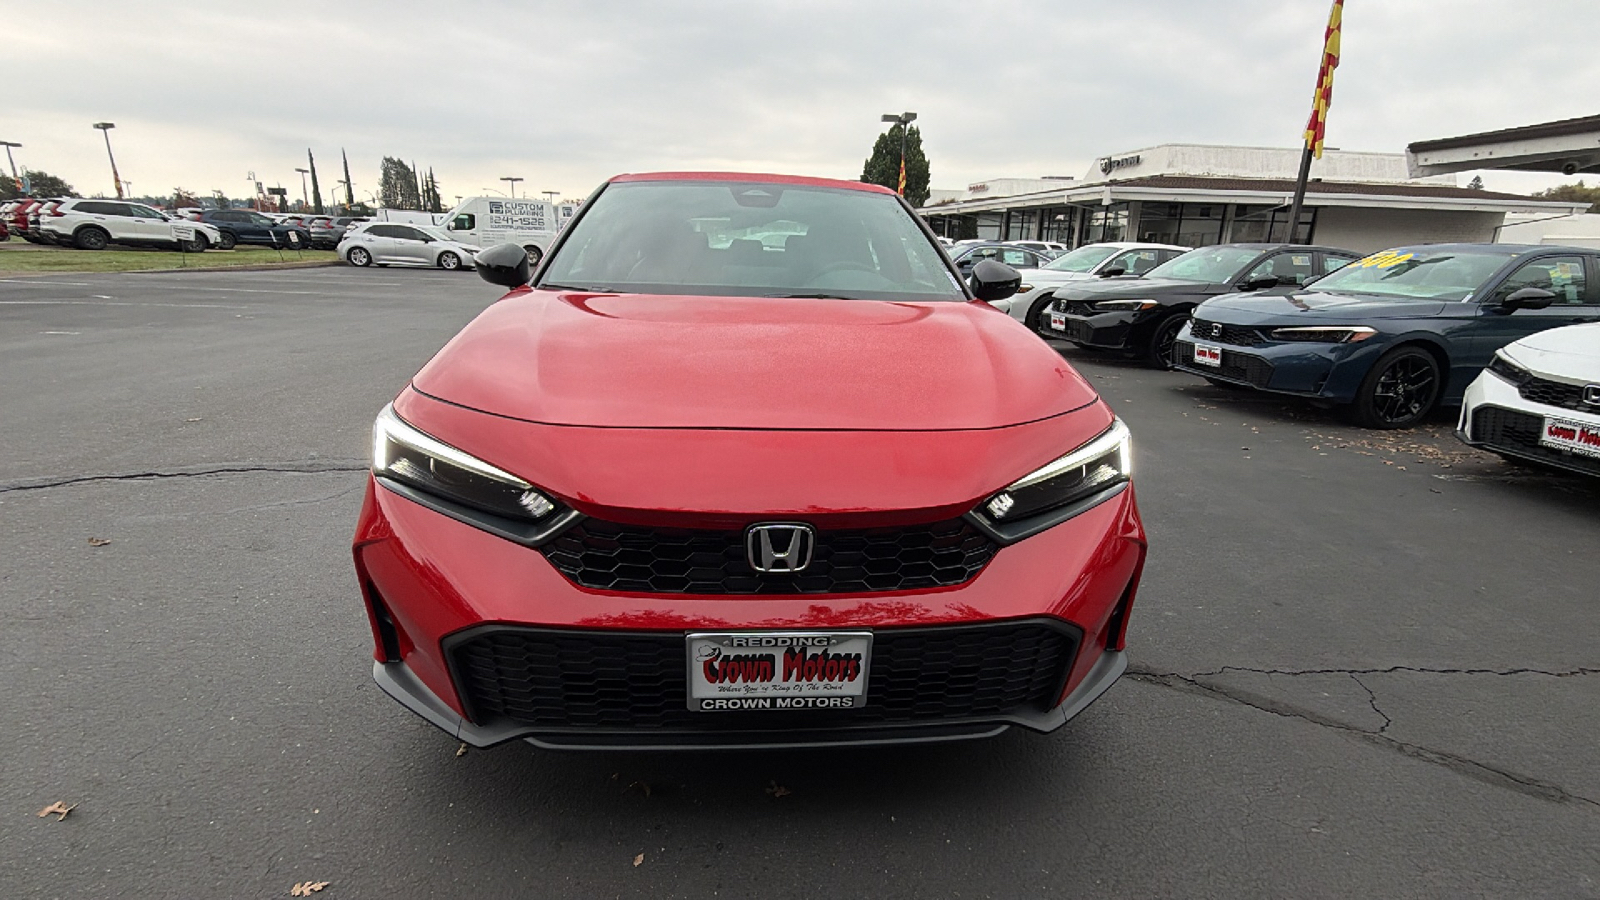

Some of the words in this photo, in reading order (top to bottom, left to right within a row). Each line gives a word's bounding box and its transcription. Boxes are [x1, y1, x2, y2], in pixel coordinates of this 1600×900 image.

[504, 202, 544, 211] CUSTOM
[504, 209, 545, 218] PLUMBING
[494, 216, 546, 226] 241-1526
[1542, 441, 1571, 451] CROWN
[733, 636, 828, 647] REDDING
[703, 650, 775, 684] Crown
[782, 647, 862, 682] Motors
[718, 684, 742, 693] Where
[771, 684, 790, 692] King
[793, 684, 804, 692] Of
[806, 683, 819, 691] The
[823, 683, 844, 691] Road
[701, 698, 771, 709] CROWN
[776, 697, 853, 708] MOTORS
